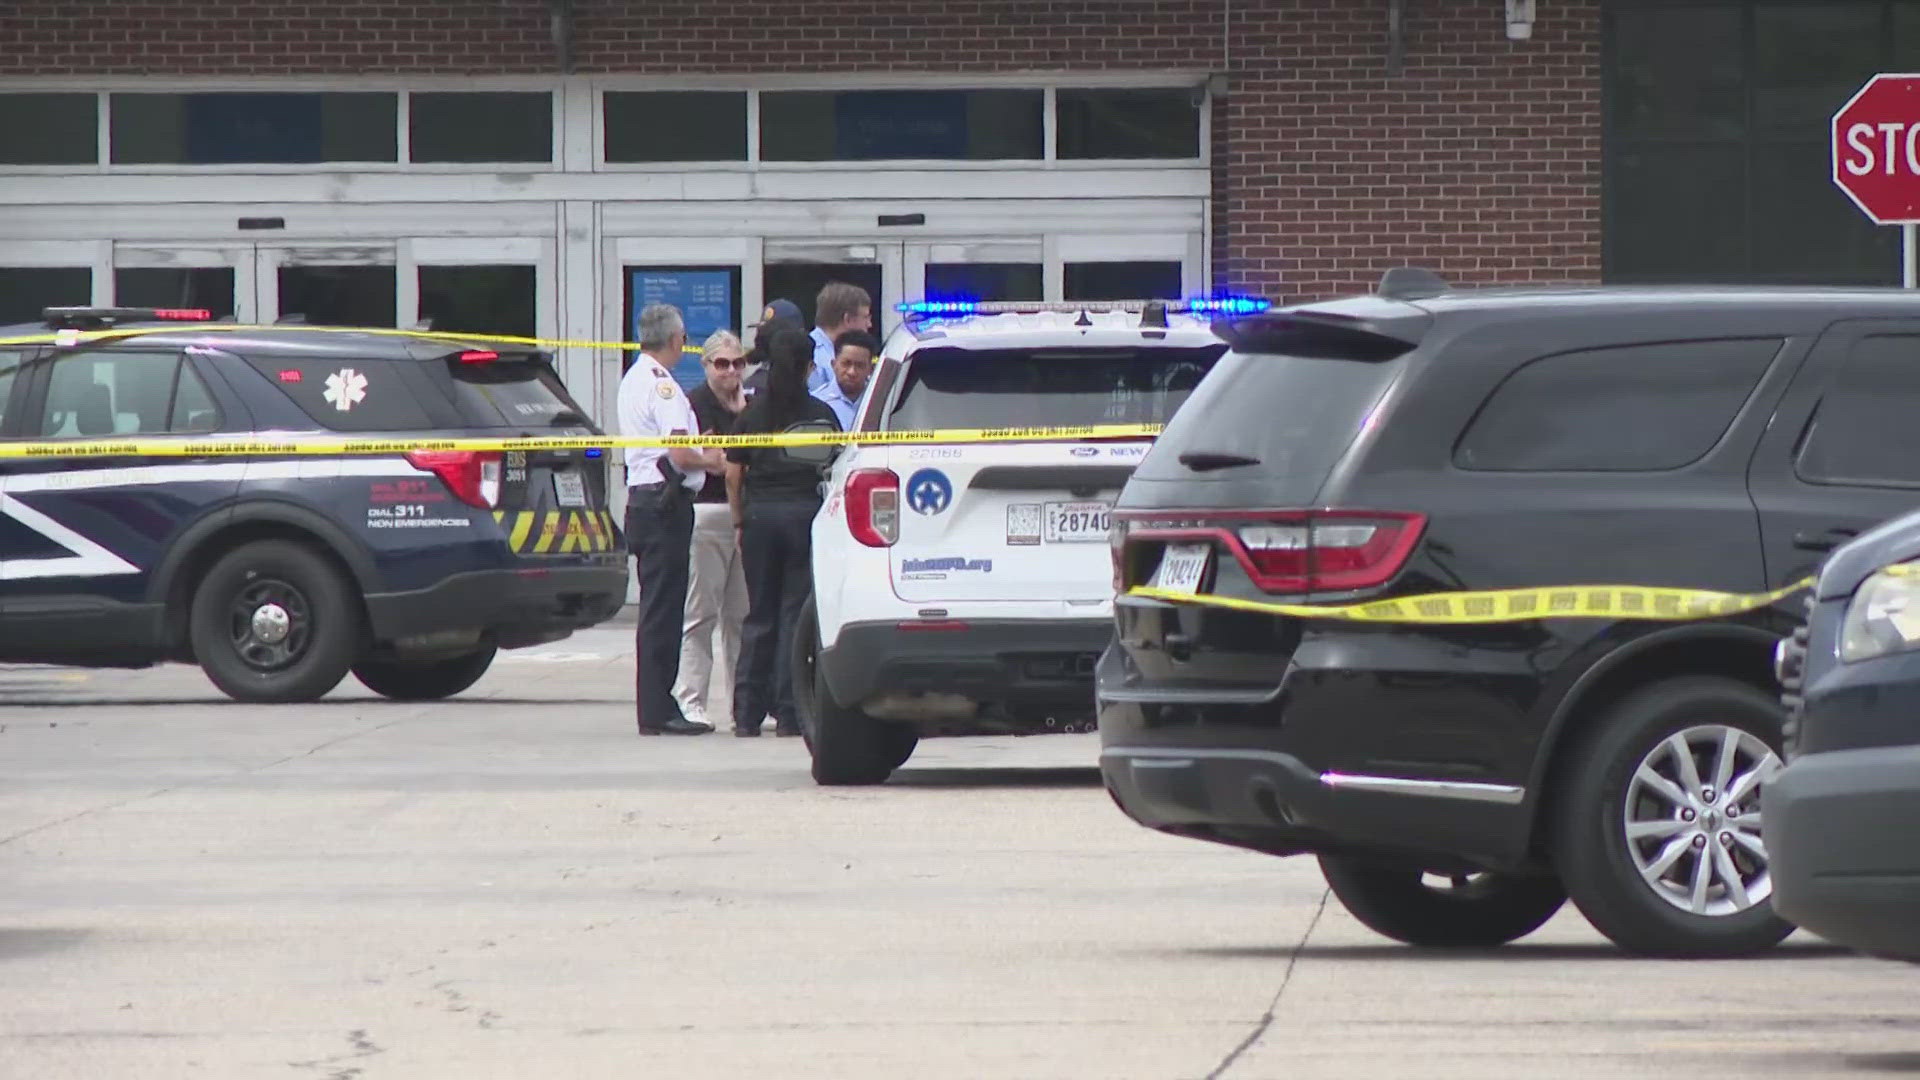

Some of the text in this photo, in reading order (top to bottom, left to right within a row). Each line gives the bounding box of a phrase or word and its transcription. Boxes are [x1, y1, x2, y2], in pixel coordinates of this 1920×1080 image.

[1110, 447, 1144, 456] NEW
[367, 505, 425, 517] DIAL 311
[367, 519, 394, 528] NON
